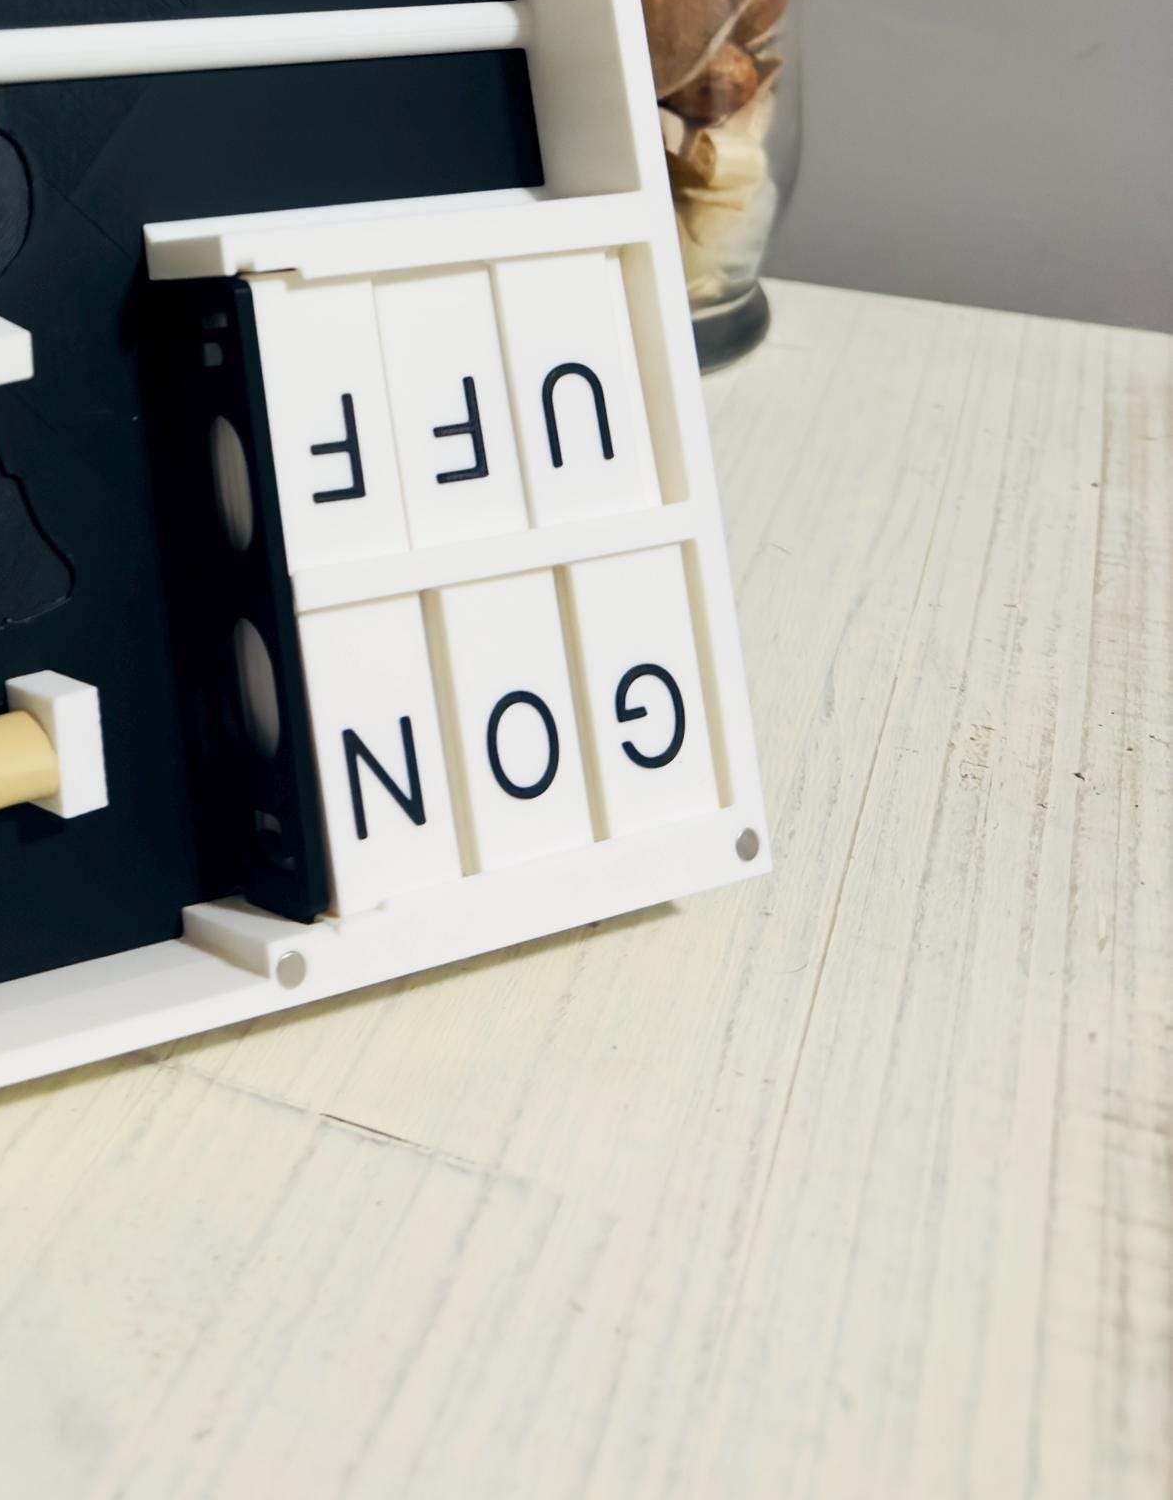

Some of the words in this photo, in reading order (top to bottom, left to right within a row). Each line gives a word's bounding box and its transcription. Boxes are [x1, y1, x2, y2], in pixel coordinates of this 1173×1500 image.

[310, 393, 366, 504] F
[432, 376, 490, 485] F
[541, 362, 615, 469] U
[486, 690, 560, 800] O
[614, 663, 686, 769] G
[341, 715, 428, 841] N
